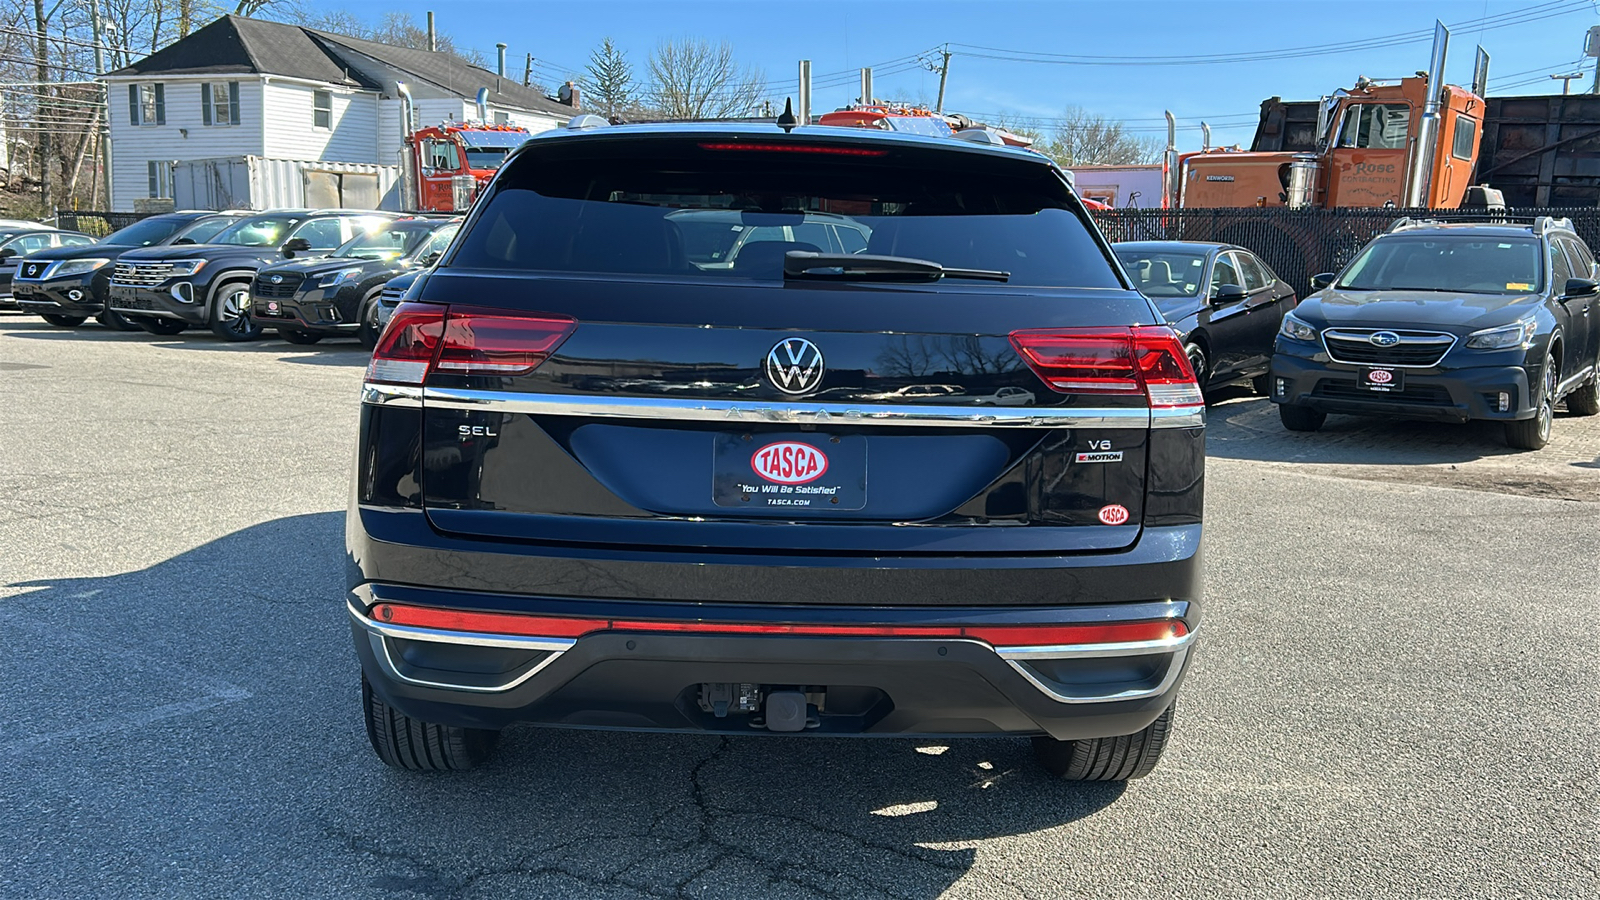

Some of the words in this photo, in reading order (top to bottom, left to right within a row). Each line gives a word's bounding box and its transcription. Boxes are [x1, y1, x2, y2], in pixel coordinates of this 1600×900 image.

[1353, 162, 1395, 175] Rose
[1371, 371, 1390, 381] TASCA
[458, 424, 497, 436] SEL
[1088, 440, 1111, 450] V6
[760, 446, 818, 478] TASCA
[762, 485, 778, 494] Will
[780, 485, 793, 494] Be
[1102, 507, 1125, 522] TASCA
